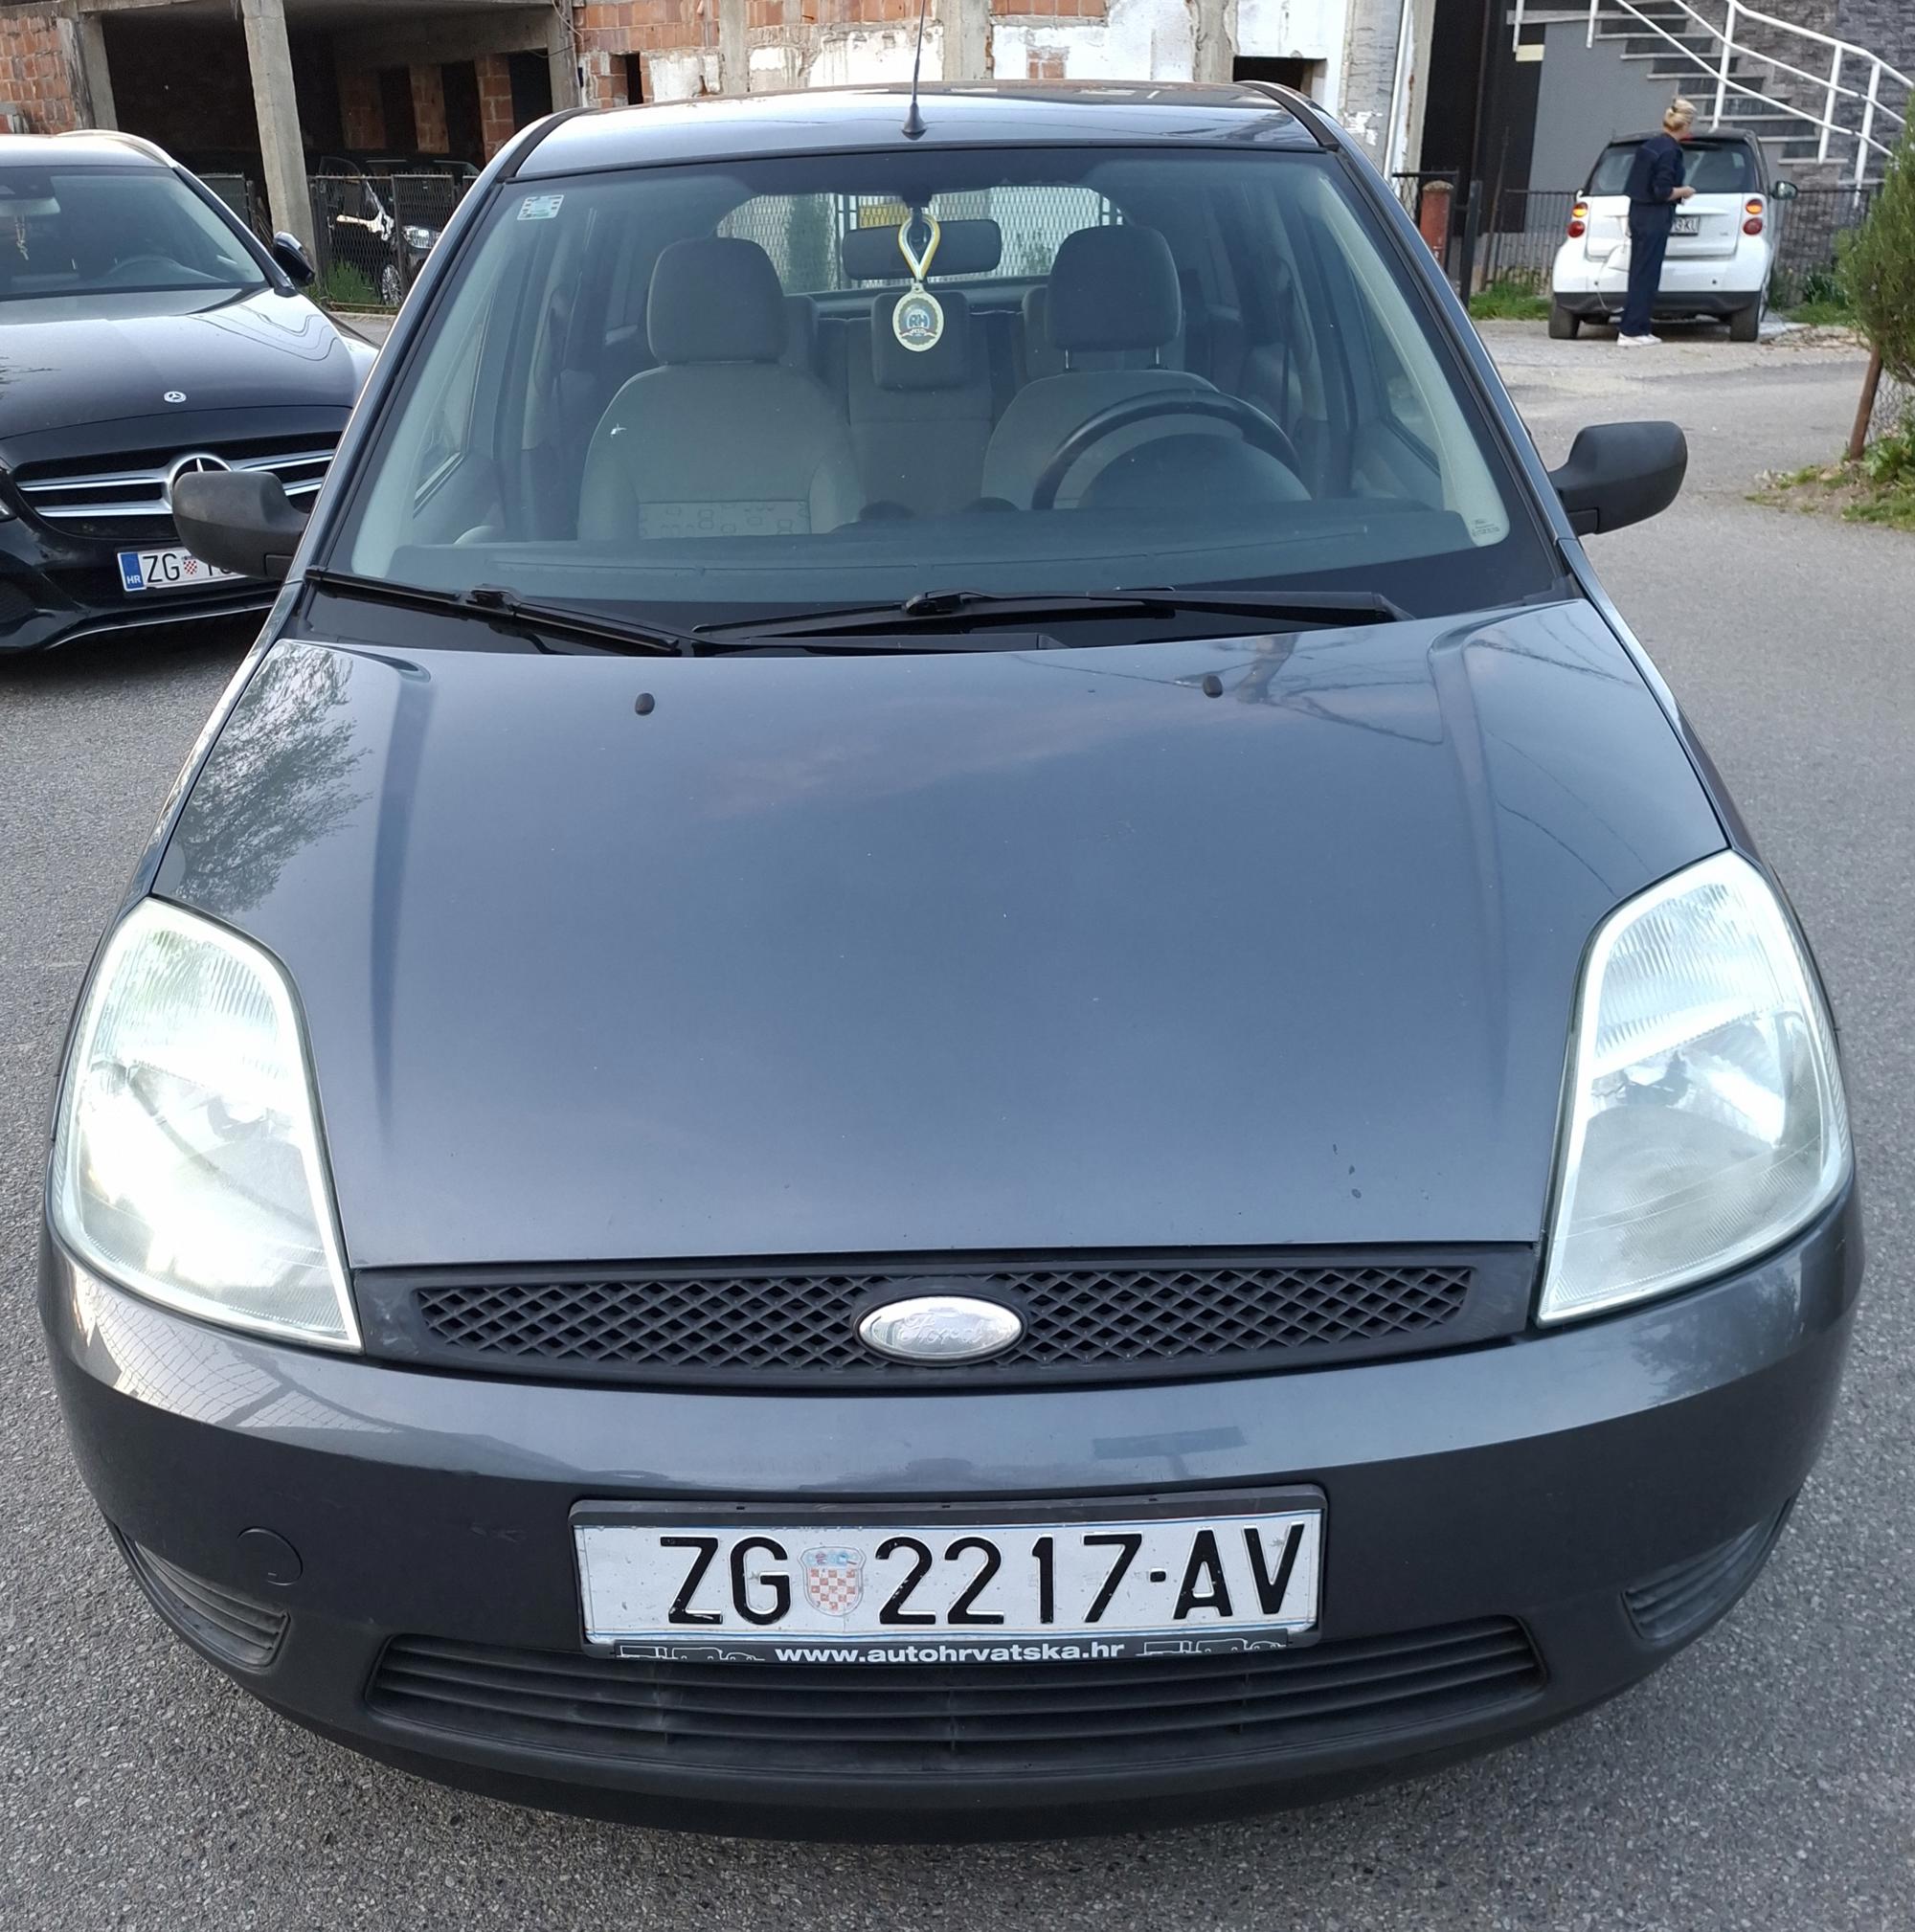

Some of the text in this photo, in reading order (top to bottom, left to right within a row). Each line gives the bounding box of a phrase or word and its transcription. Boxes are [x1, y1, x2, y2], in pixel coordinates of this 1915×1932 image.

[126, 574, 142, 585] HR
[143, 553, 180, 583] ZG
[898, 1312, 985, 1345] Ford
[659, 1523, 1305, 1626] ZG 2217-AV
[775, 1642, 1125, 1663] www.autohrvatska.hr
